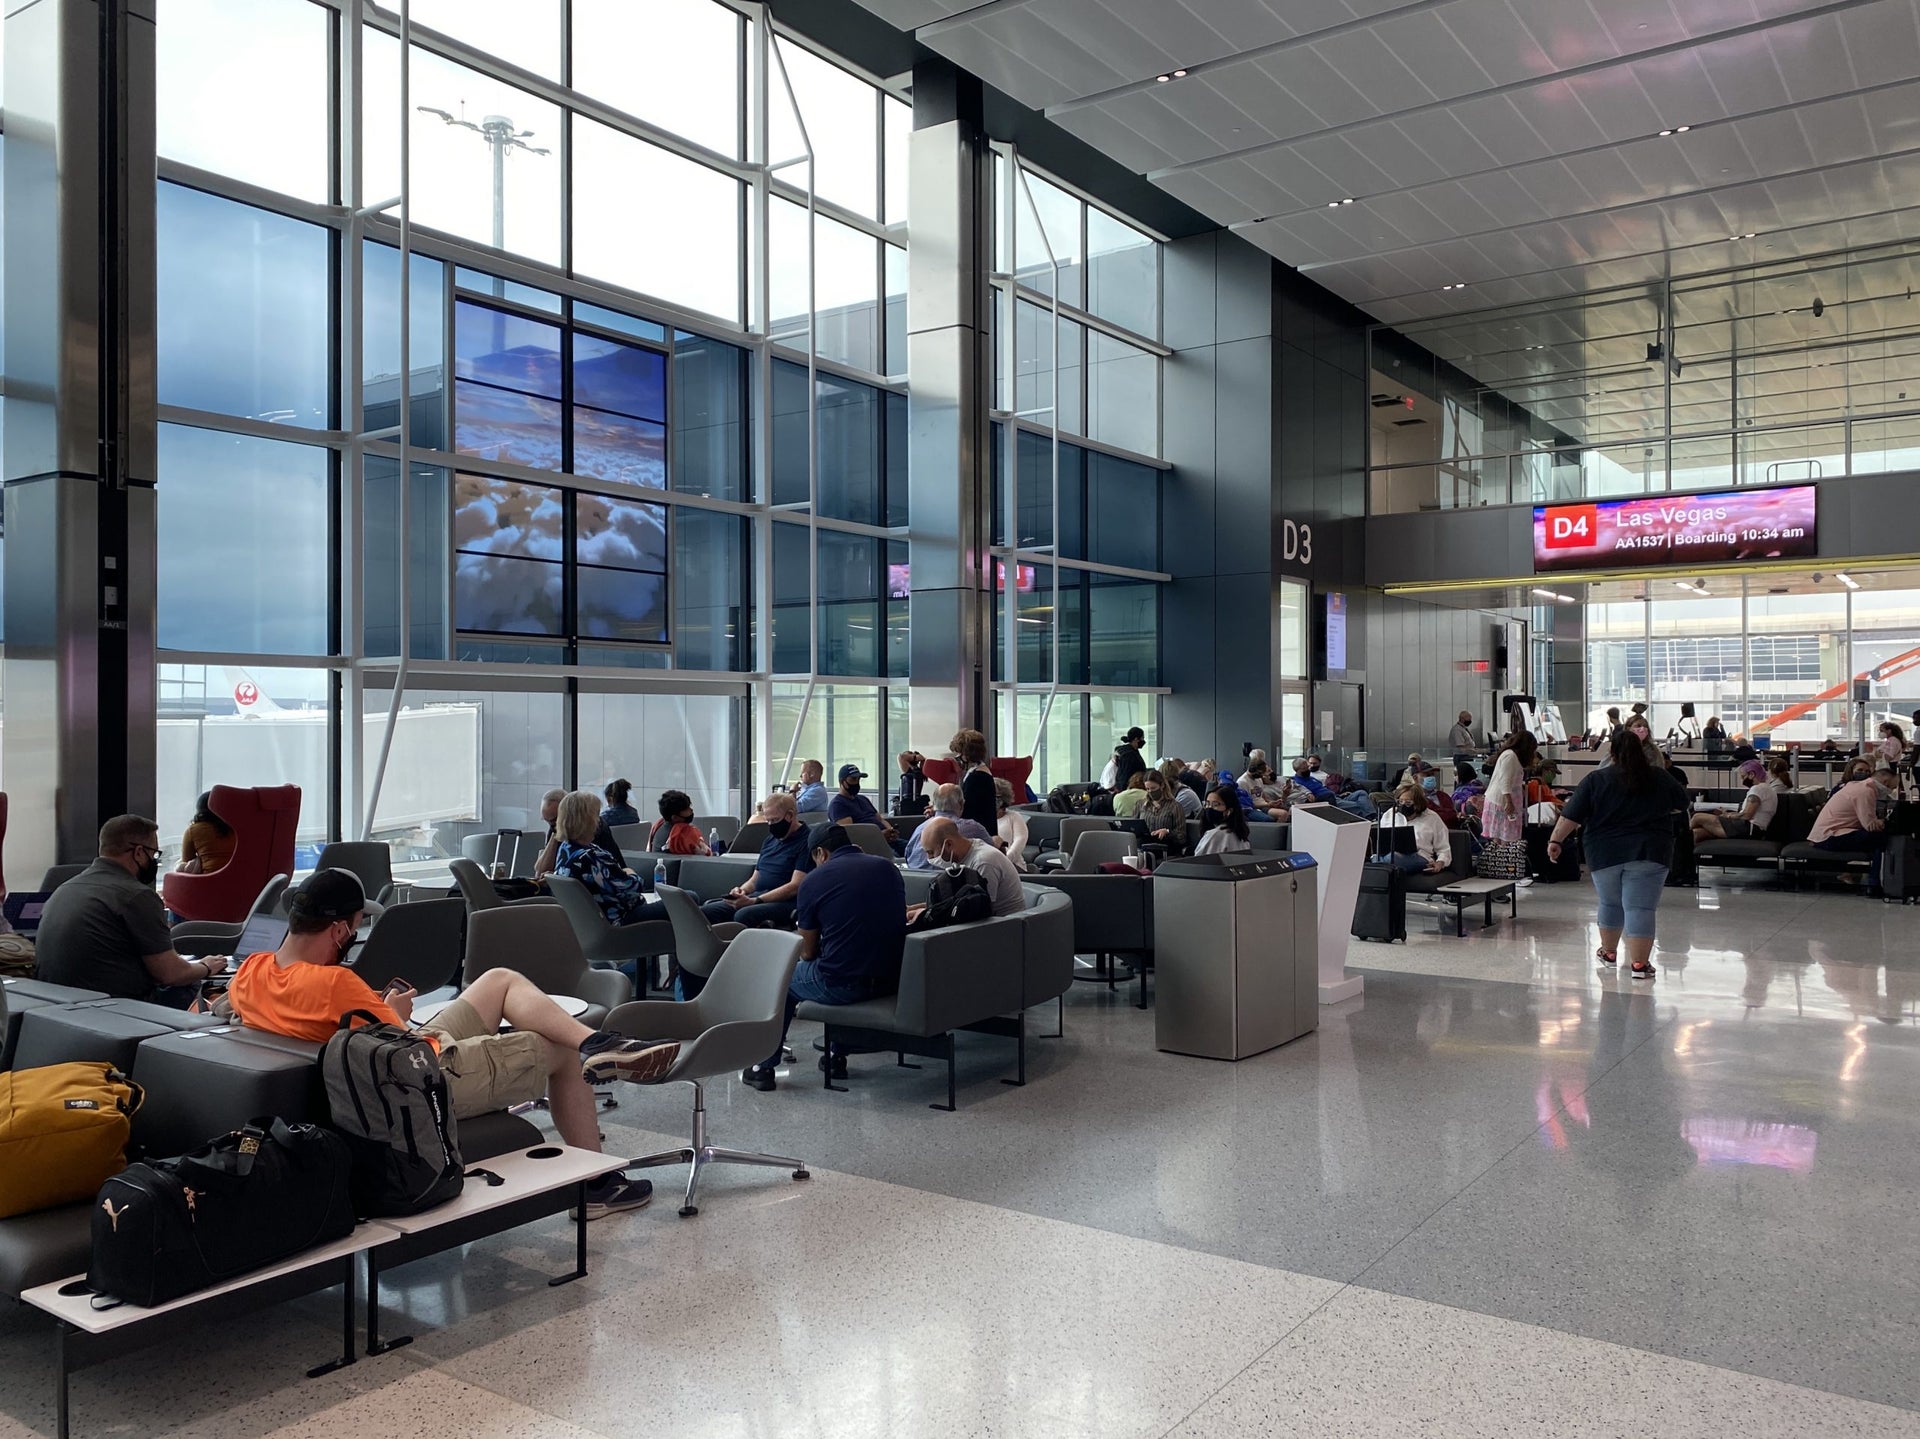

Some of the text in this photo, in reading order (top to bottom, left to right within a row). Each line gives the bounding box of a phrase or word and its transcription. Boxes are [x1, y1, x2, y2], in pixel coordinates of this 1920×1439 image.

[1554, 515, 1588, 539] D4
[1616, 505, 1727, 528] Las Vegas
[1283, 519, 1312, 565] D3
[1615, 535, 1664, 549] AA1537
[1675, 532, 1736, 546] Boarding
[1742, 528, 1778, 541] 10:34
[1782, 527, 1804, 538] am
[431, 1091, 441, 1123] UNDER
